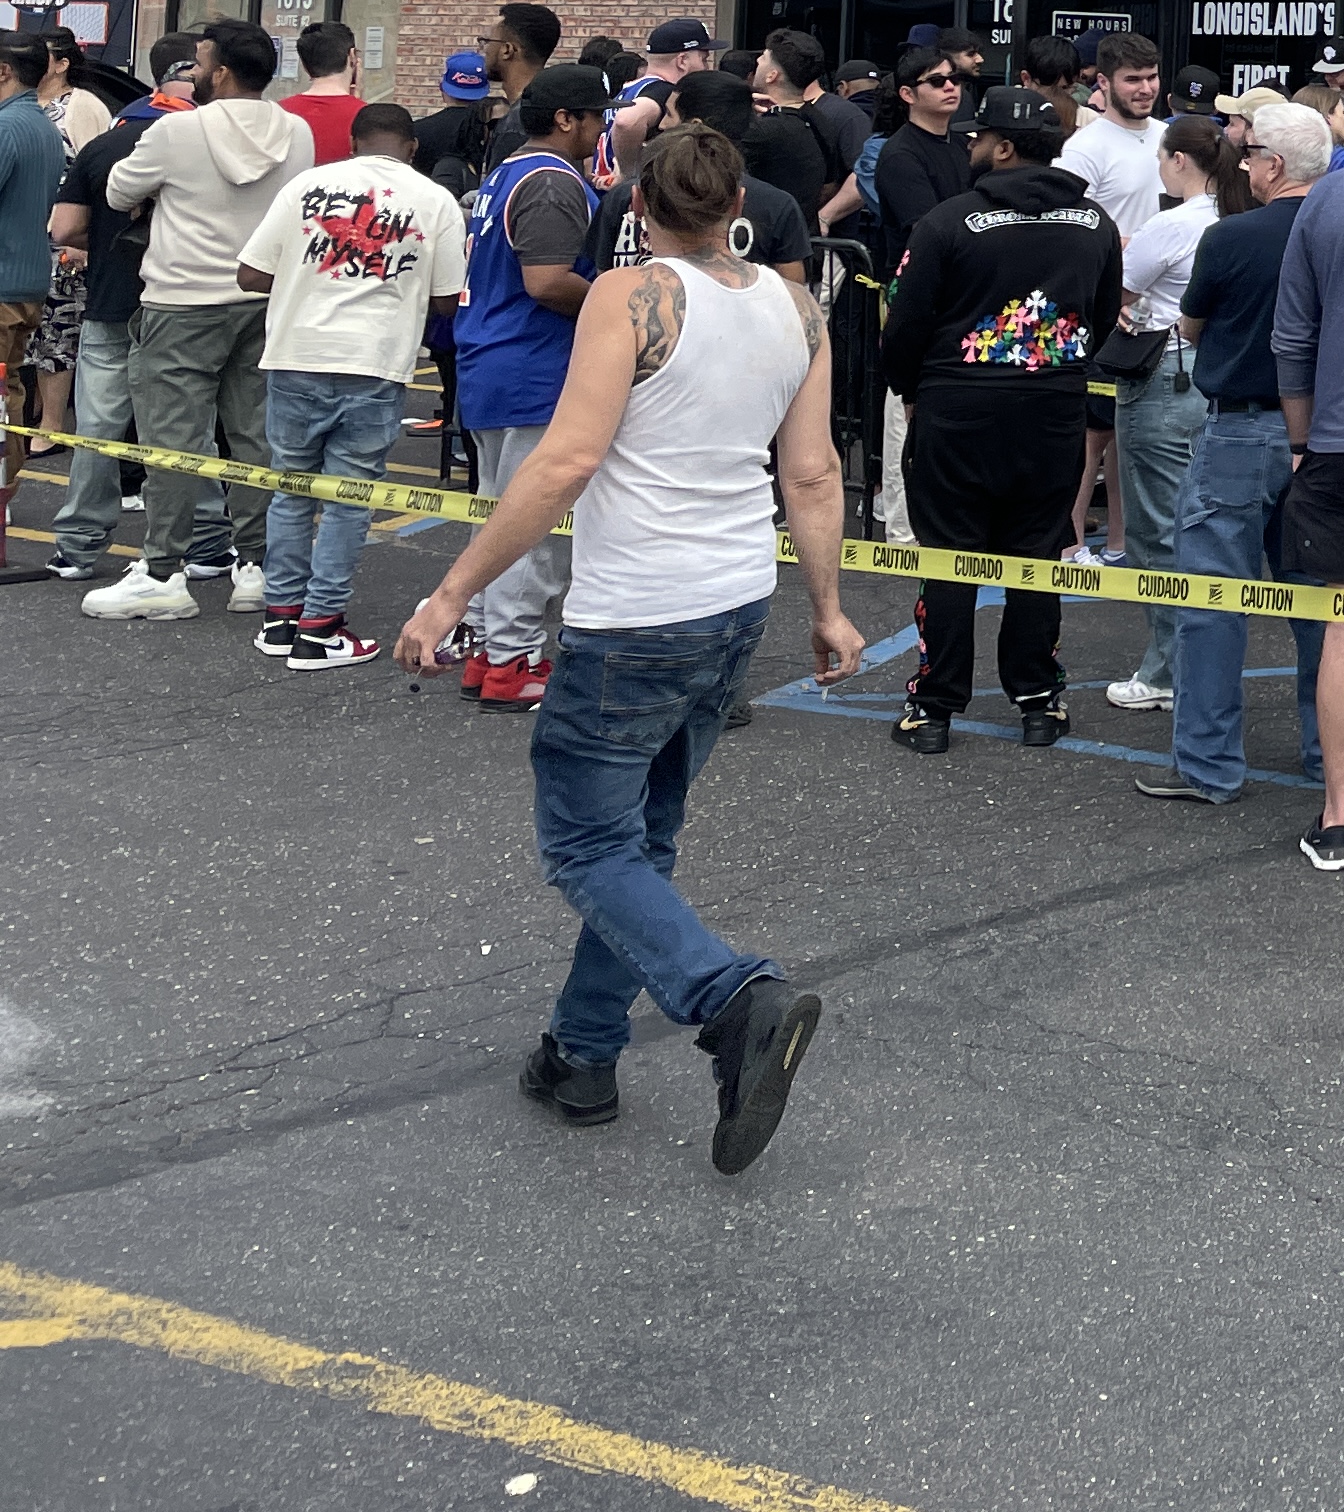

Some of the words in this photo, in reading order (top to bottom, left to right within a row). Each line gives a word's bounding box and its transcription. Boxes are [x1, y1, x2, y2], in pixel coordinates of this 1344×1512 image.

[275, 15, 298, 27] SUITE
[1057, 18, 1081, 29] NEW
[1088, 20, 1127, 31] HOURS
[1192, 2, 1335, 36] LONGISLAND'S
[301, 186, 374, 224] BET
[366, 207, 416, 243] ON
[302, 232, 419, 281] MYSELF
[336, 480, 374, 501] CUIDADO
[406, 489, 444, 512] CAUTION
[468, 498, 499, 518] CUIDA
[873, 546, 919, 571] CAUTION
[954, 555, 1003, 581] CUIDADO
[1051, 565, 1101, 592] CAUTION
[1138, 574, 1189, 601] CUIDADO
[1240, 584, 1293, 612] CAUTION
